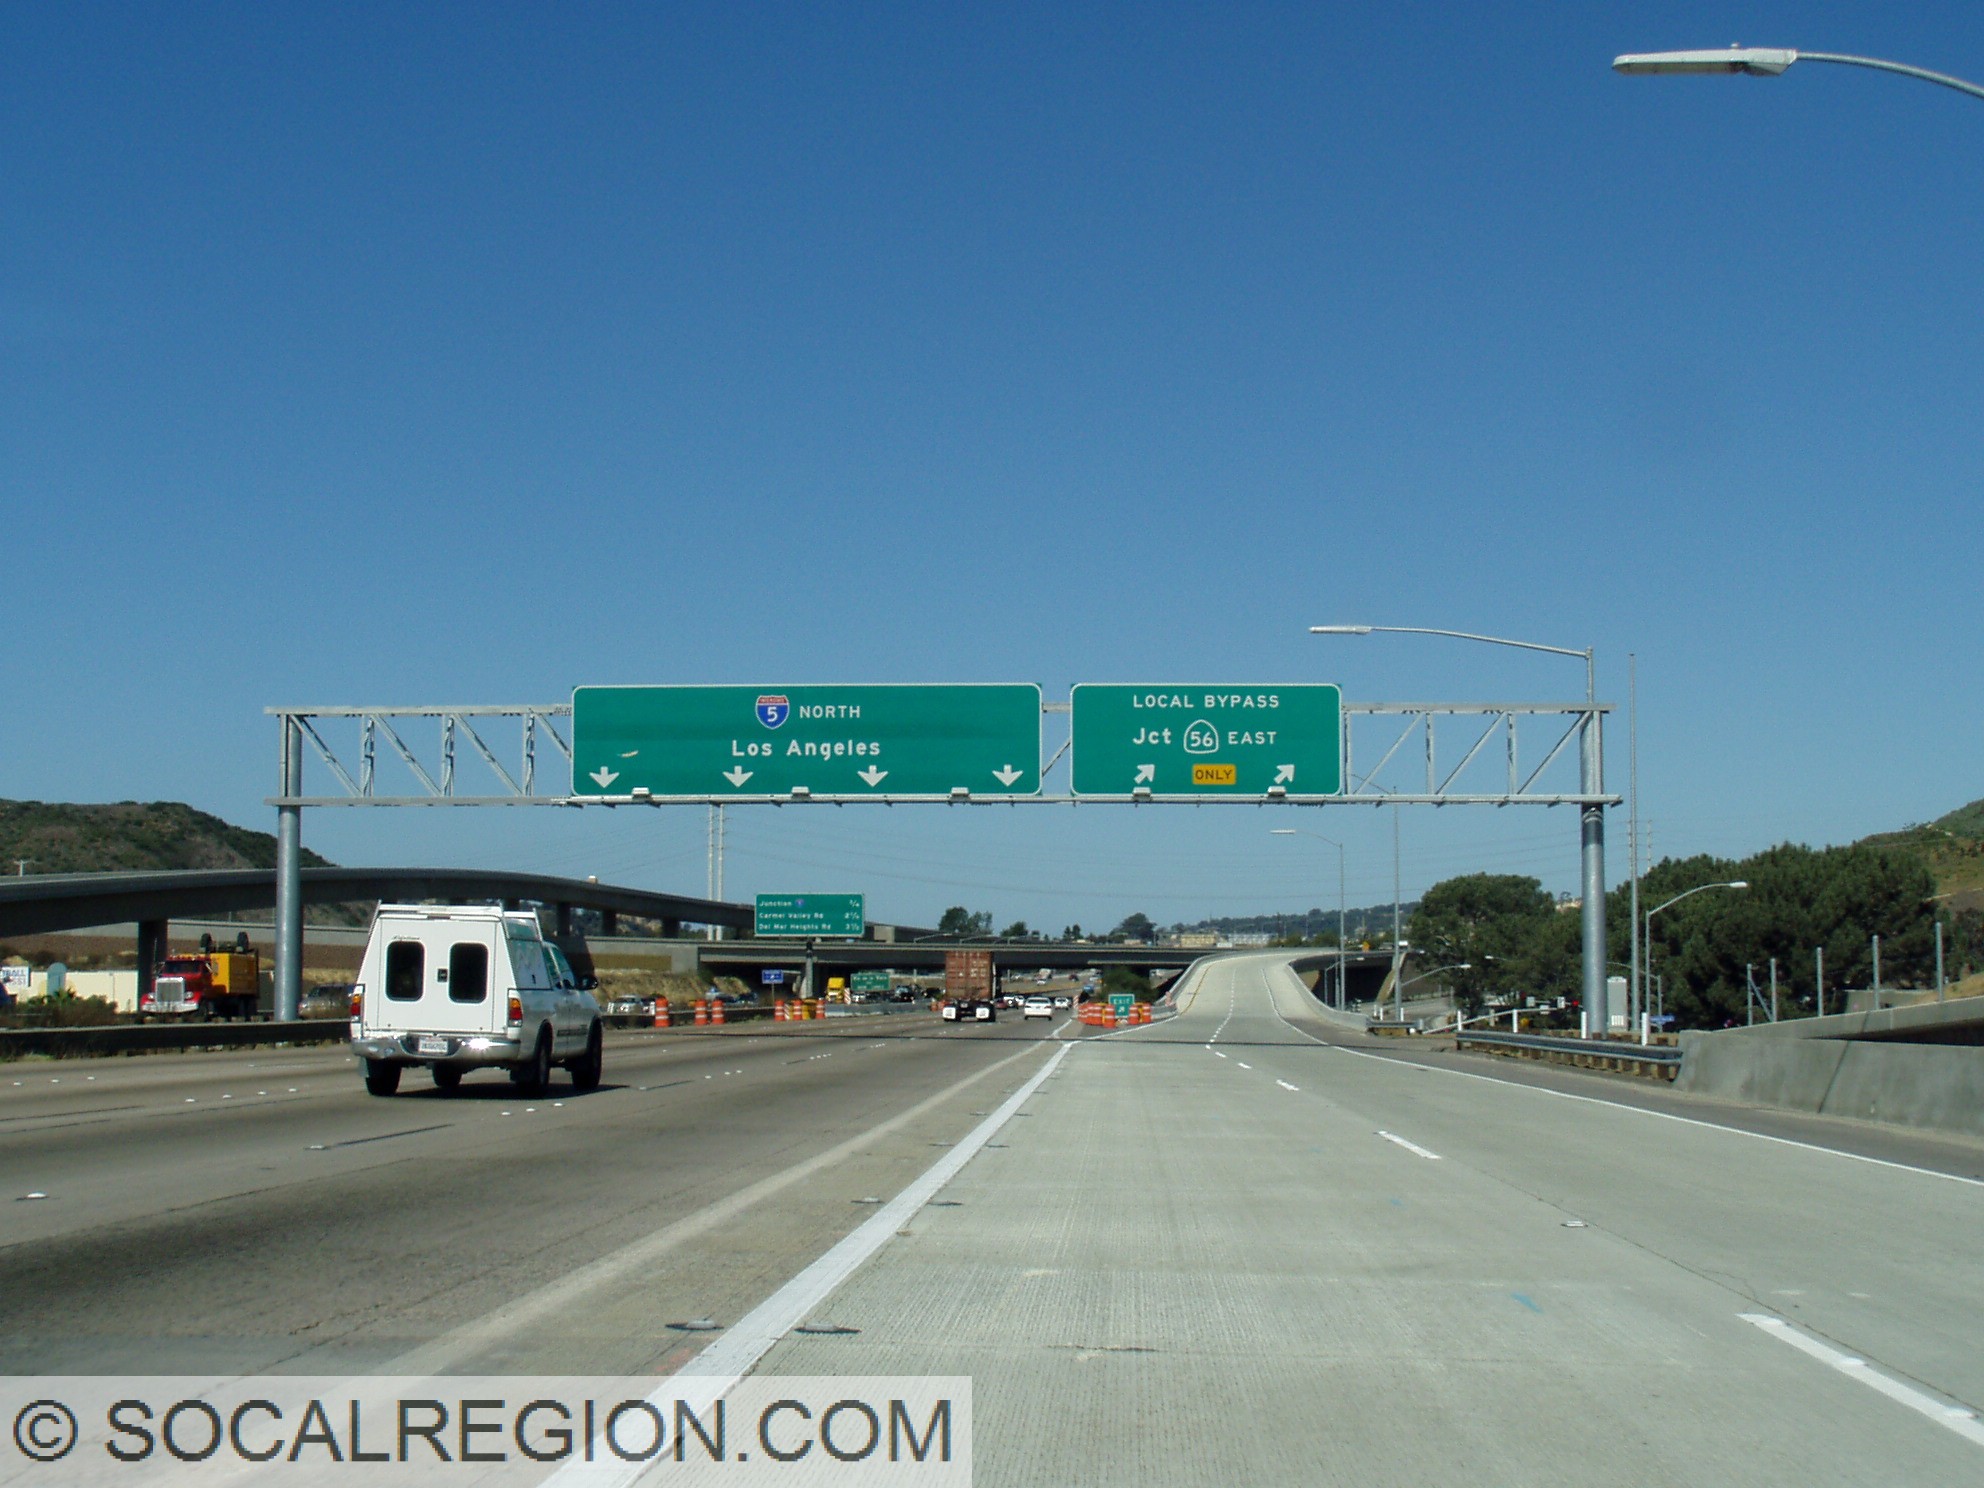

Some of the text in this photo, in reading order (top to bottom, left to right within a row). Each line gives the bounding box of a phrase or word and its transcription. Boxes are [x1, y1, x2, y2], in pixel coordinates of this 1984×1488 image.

[1132, 694, 1280, 708] LOCAL BYPASS
[766, 705, 861, 722] 5 NORTH
[1132, 727, 1277, 747] Jct 56 EAST
[731, 739, 881, 761] Los Angeles
[1194, 769, 1233, 780] ONLY
